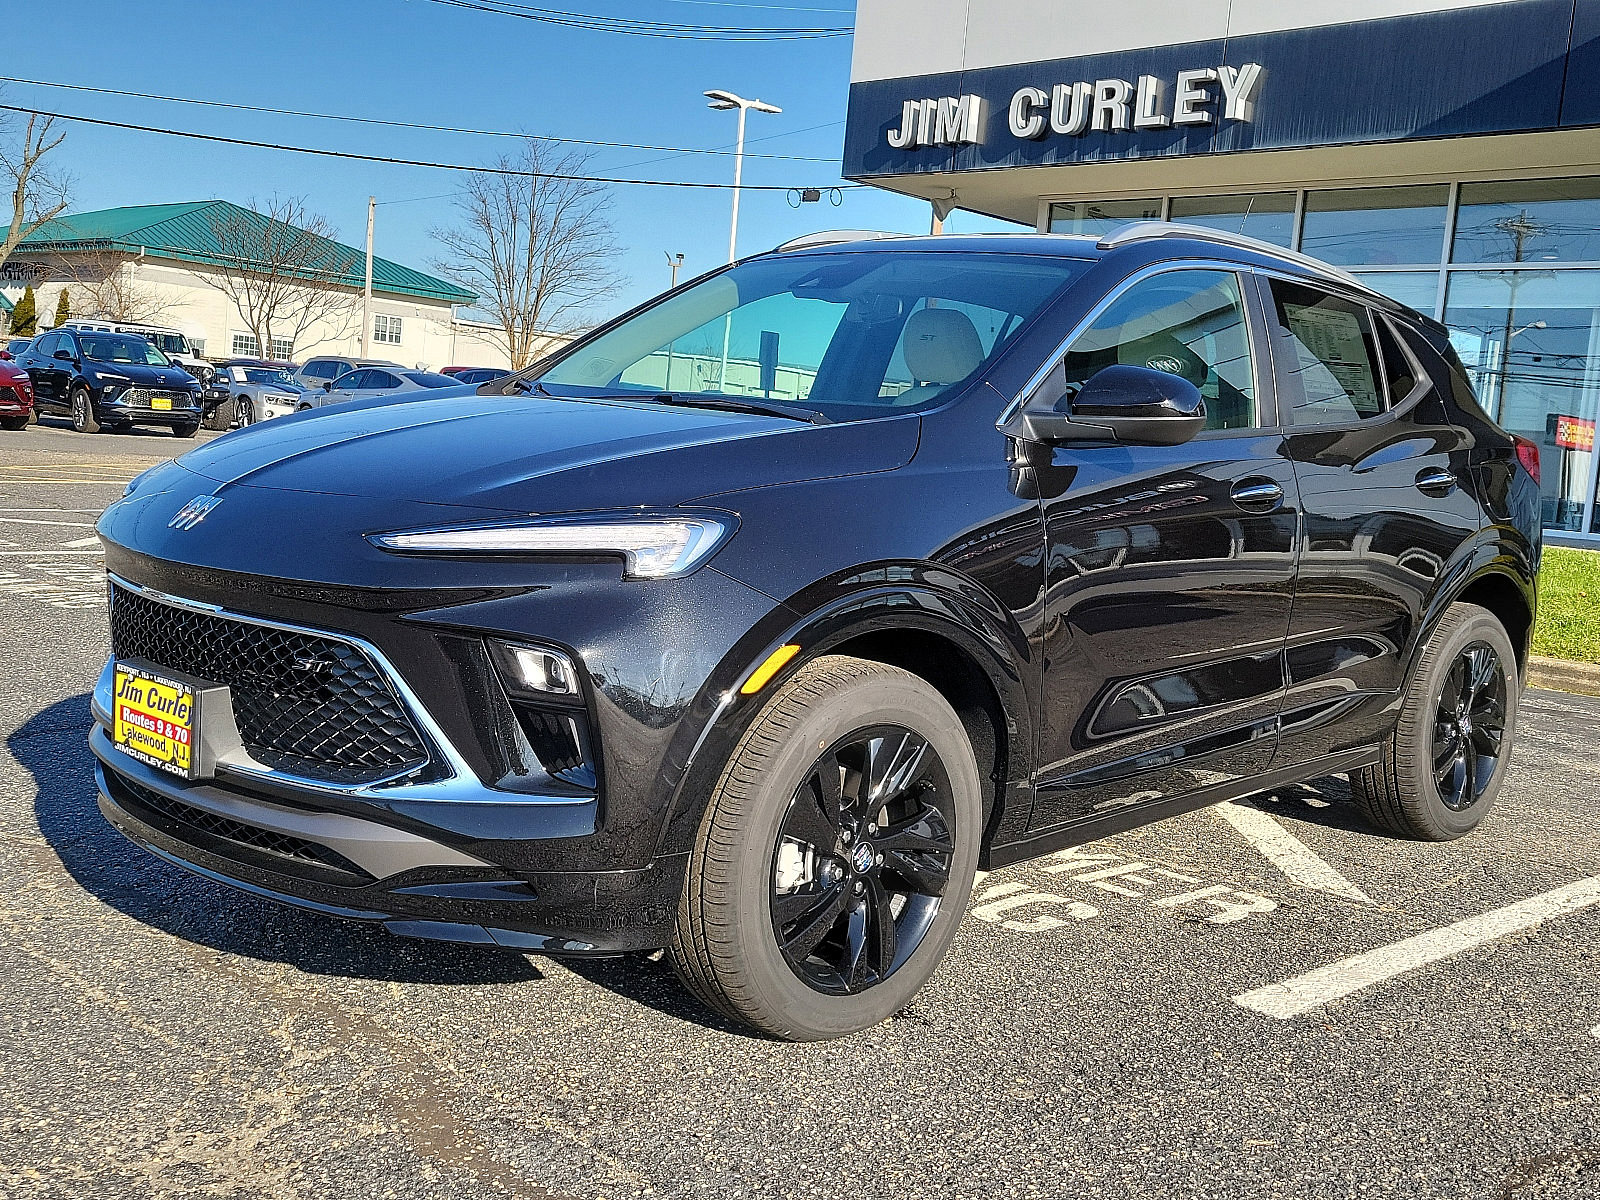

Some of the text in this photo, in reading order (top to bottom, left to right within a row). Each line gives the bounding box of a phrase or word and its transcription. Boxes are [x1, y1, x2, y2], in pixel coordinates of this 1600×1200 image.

[887, 62, 1262, 148] JIM CURLEY
[118, 677, 142, 704] Jim
[121, 722, 169, 756] Lakewood,
[123, 706, 187, 743] Routes 9 & 70
[114, 743, 189, 778] JIMCURLEY.COM
